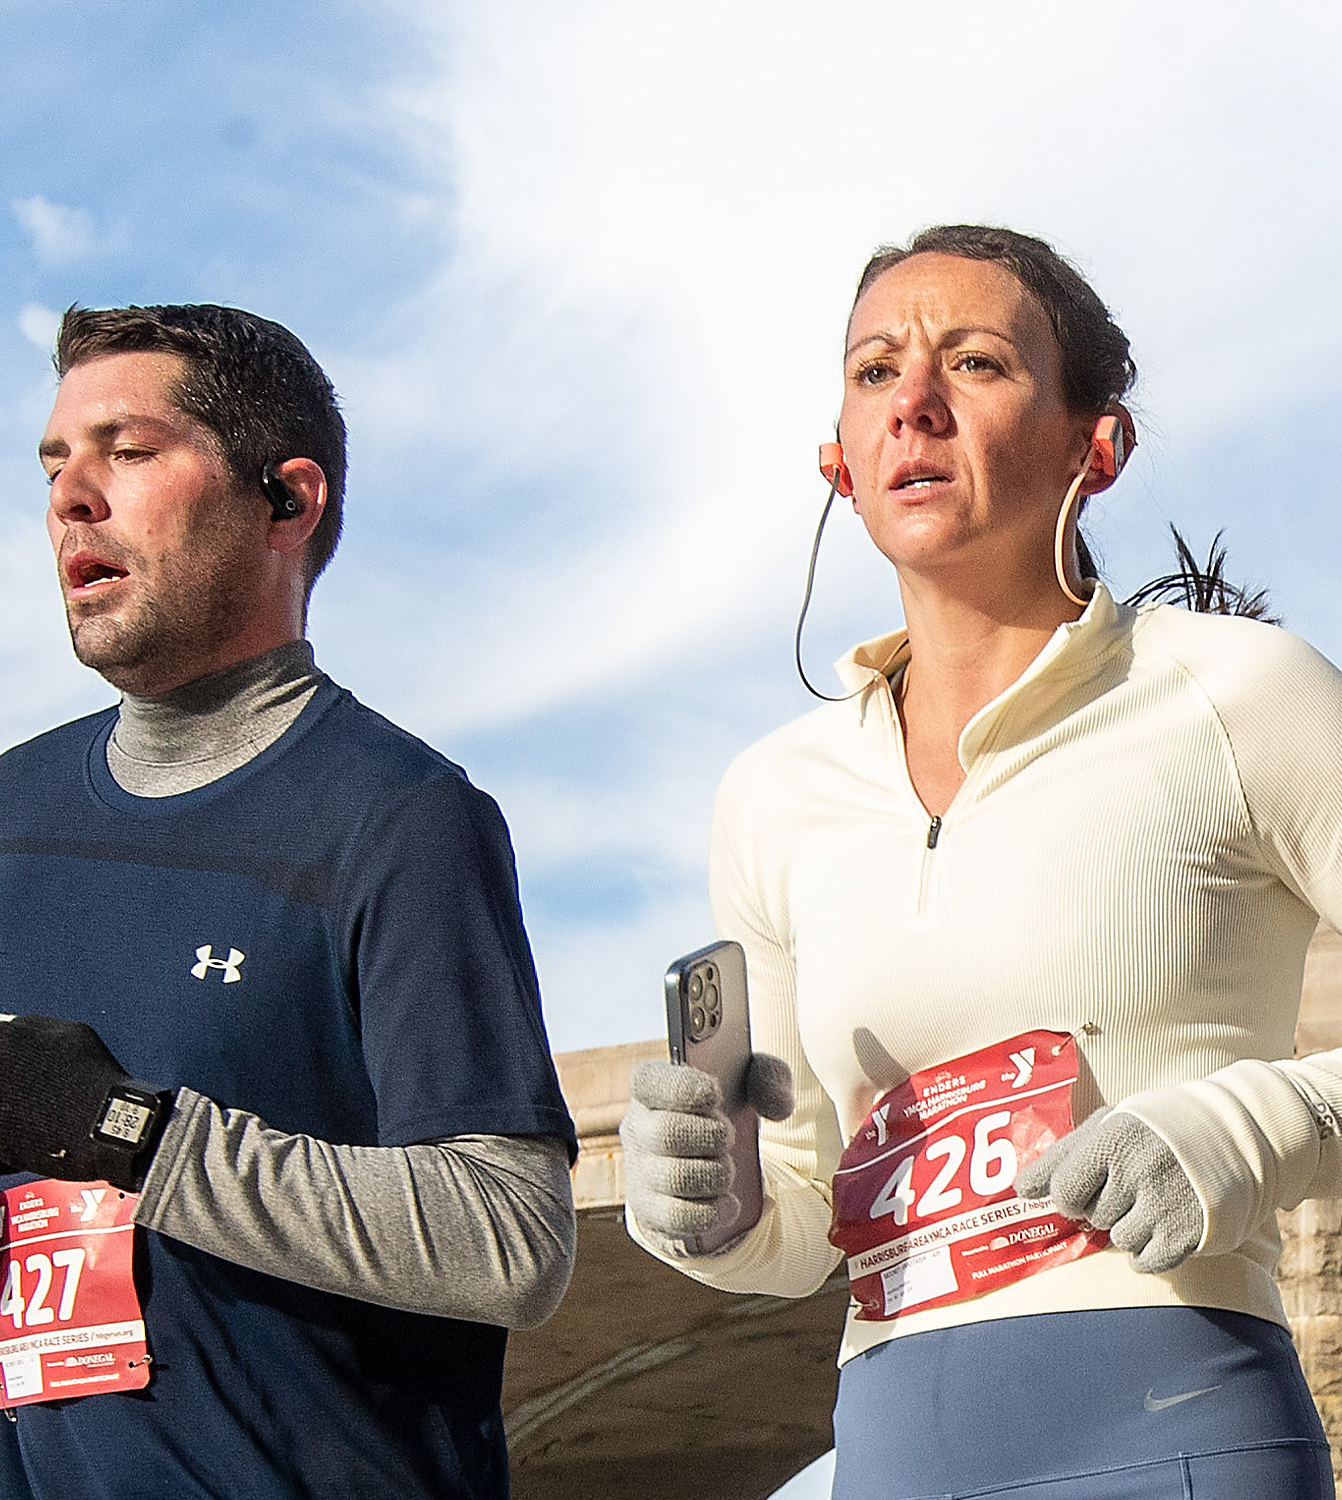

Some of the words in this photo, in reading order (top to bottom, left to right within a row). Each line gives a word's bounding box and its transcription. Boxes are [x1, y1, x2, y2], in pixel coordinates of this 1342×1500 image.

[922, 1075, 966, 1097] ENDERS
[903, 1098, 928, 1118] YMCA
[927, 1080, 986, 1106] HARRISBURG
[919, 1094, 968, 1120] MARATHON
[870, 1110, 1018, 1226] 426
[906, 1235, 930, 1252] AREA
[928, 1227, 951, 1243] YMCA
[951, 1218, 979, 1236] RACE
[981, 1204, 1021, 1226] SERIES
[1008, 1223, 1057, 1245] DONEGAL
[972, 1268, 989, 1280] FULL
[988, 1257, 1025, 1277] MARATHON
[0, 1248, 86, 1329] 427
[62, 1332, 90, 1345] SERIES
[78, 1352, 116, 1366] DONEGAL
